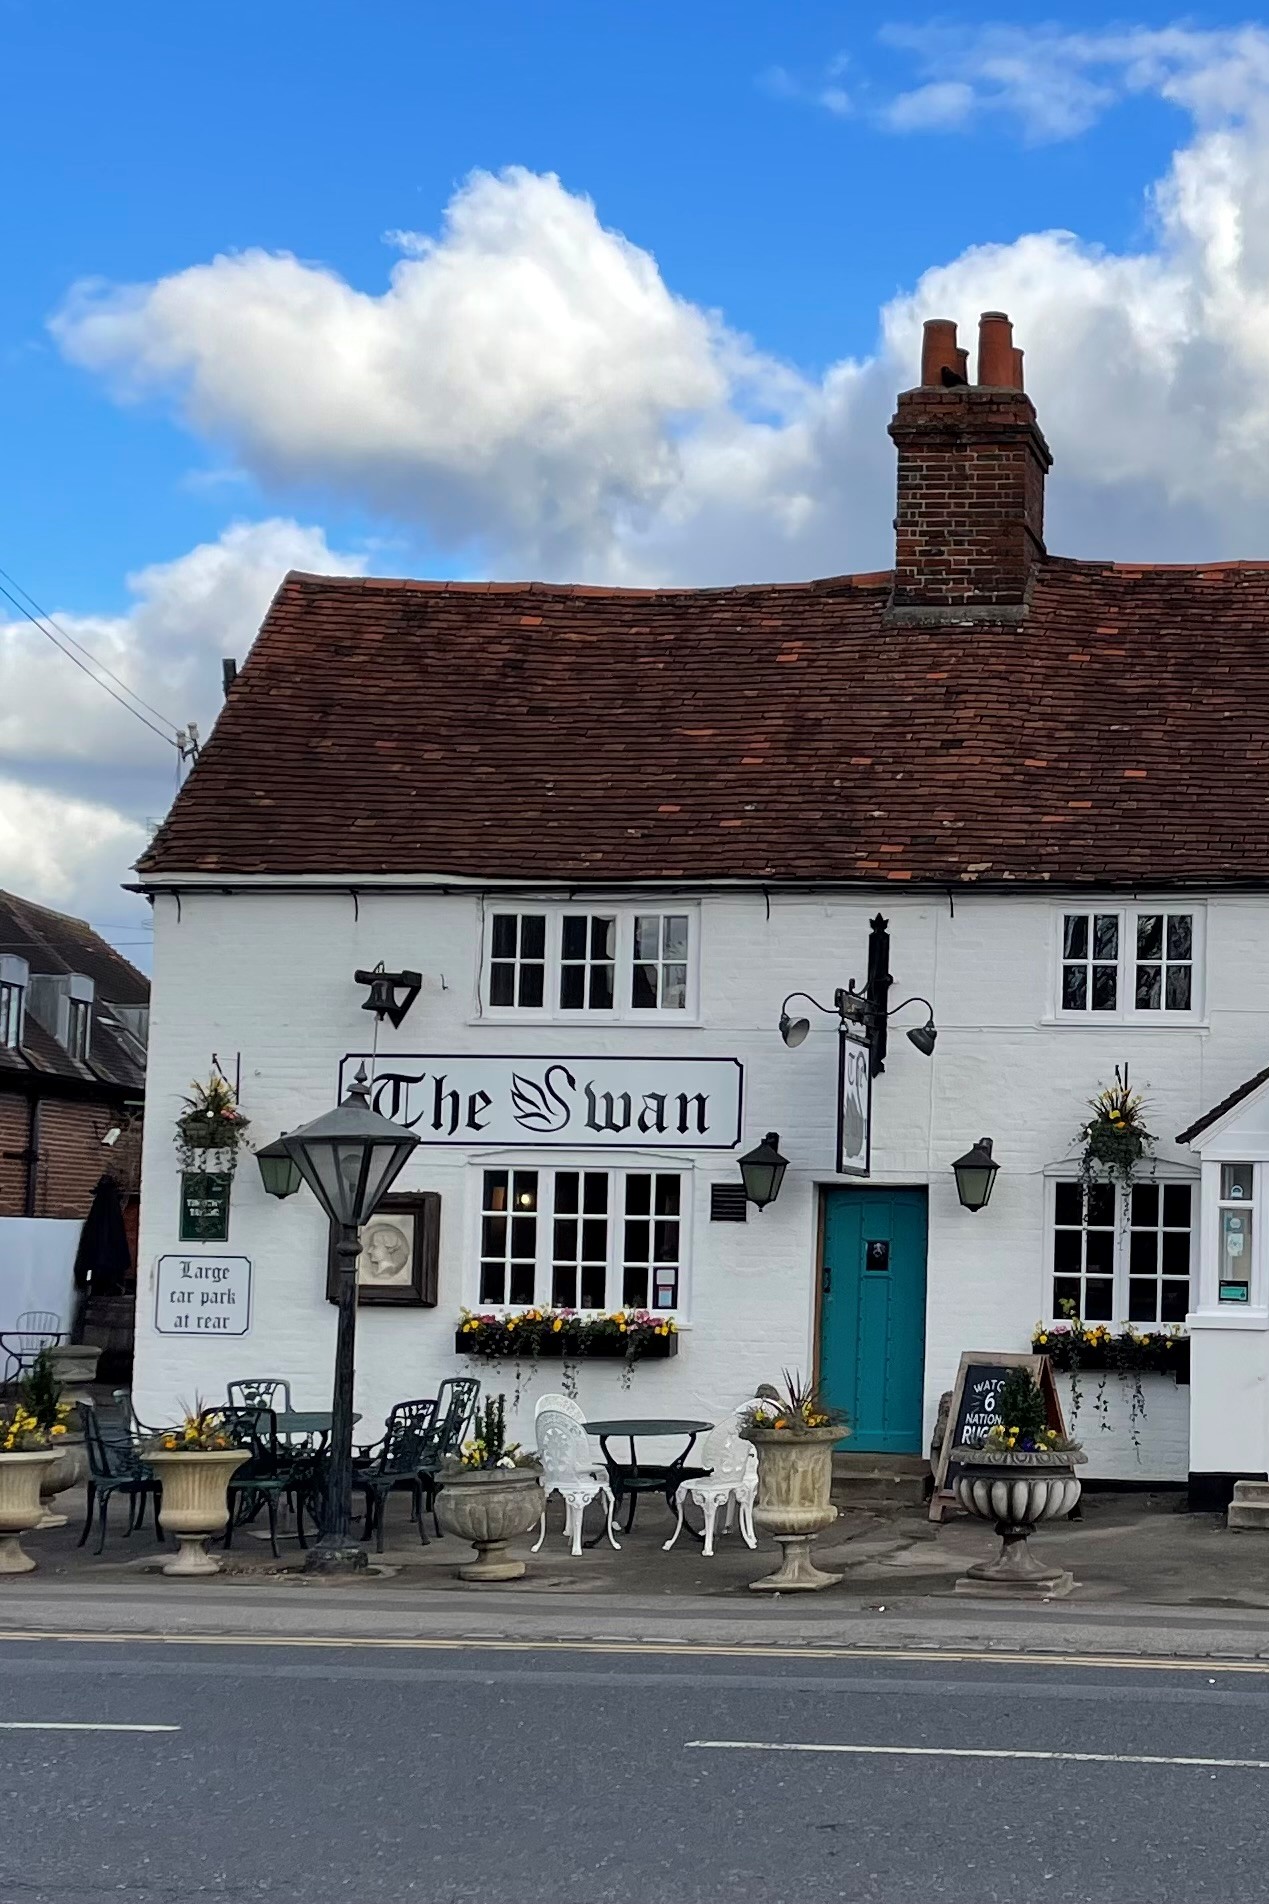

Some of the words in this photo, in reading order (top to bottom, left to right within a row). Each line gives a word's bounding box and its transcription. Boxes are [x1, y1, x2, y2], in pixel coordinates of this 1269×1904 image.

[372, 1071, 494, 1136] The
[510, 1064, 711, 1134] Swan
[179, 1261, 230, 1283] Large
[170, 1290, 194, 1304] car
[200, 1288, 236, 1306] park
[174, 1313, 190, 1329] at
[196, 1315, 230, 1329] rear
[973, 1380, 1006, 1393] WATC
[984, 1392, 996, 1412] 6
[965, 1413, 1004, 1425] NATION
[961, 1425, 990, 1444] RUG
